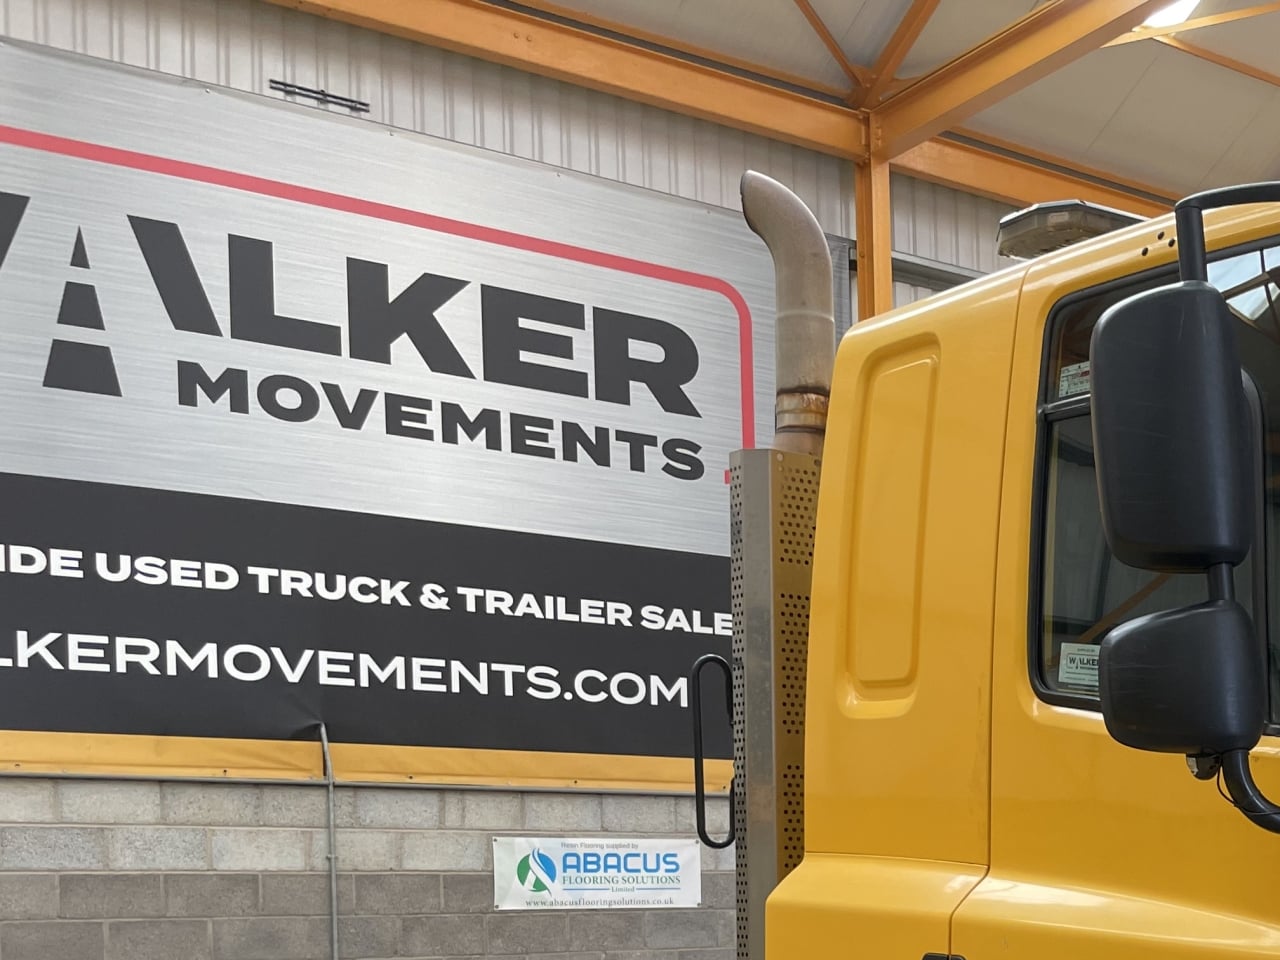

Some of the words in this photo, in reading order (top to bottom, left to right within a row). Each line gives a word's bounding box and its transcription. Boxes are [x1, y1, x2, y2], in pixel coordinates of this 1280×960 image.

[0, 191, 703, 418] ALKER
[177, 360, 705, 482] MOVEMENTS
[95, 552, 240, 592] USED
[248, 565, 411, 608] TRUCK
[420, 584, 450, 611] &
[457, 586, 633, 627] TRAILER
[640, 605, 733, 636] SALE
[606, 842, 630, 850] supplied
[631, 842, 639, 850] by
[562, 853, 680, 873] ABACUS
[562, 875, 619, 885] FLOORING
[621, 875, 681, 885] SOLUTIONS
[525, 897, 674, 907] www.abacusflooringsolutions.co.uk
